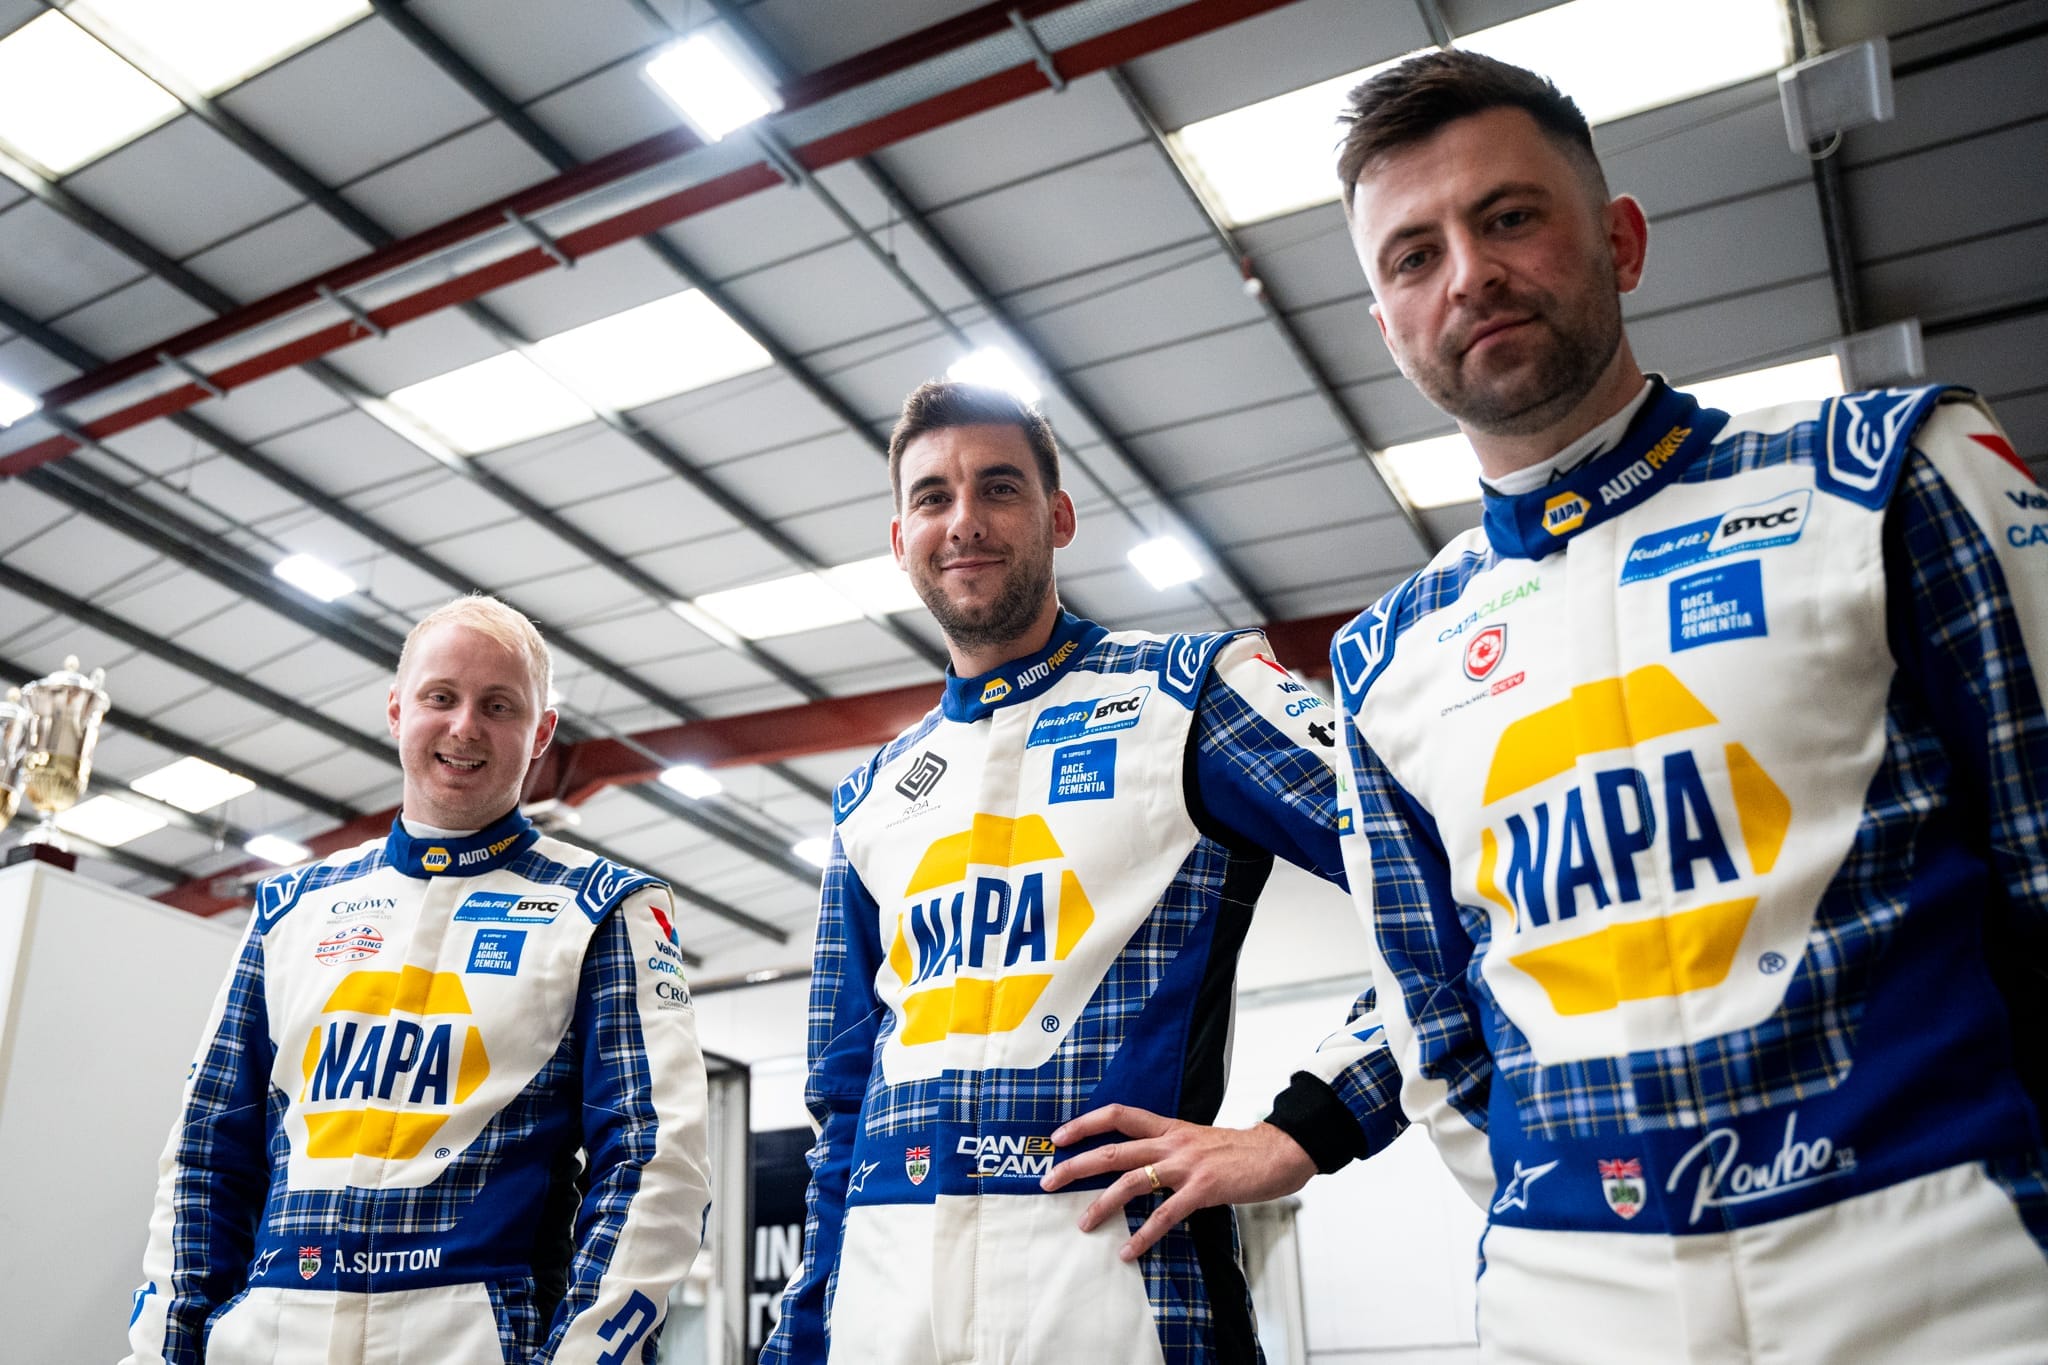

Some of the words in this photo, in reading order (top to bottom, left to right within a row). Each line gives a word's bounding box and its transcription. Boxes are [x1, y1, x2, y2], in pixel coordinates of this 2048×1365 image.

[1549, 501, 1584, 526] NAPA
[1598, 459, 1654, 506] AUTO
[1644, 425, 1693, 470] PARTS
[1722, 507, 1798, 538] BTCC
[1438, 576, 1541, 642] CATACLEAN
[1680, 591, 1714, 611] RACE
[1681, 599, 1739, 625] AGAINST
[1680, 612, 1754, 640] DEMENTIA
[984, 685, 1008, 701] NAPA
[1016, 661, 1051, 690] AUTO
[1047, 640, 1079, 671] PARTS
[1094, 696, 1141, 719] BTCC
[1059, 771, 1099, 785] AGAINST
[1060, 762, 1085, 775] RACE
[1057, 780, 1106, 796] DEMENTIA
[1505, 749, 1741, 935] NAPA
[425, 854, 448, 865] NAPA
[458, 848, 490, 866] AUTO
[331, 897, 398, 915] CROWN
[516, 901, 560, 913] BTCC
[908, 872, 1047, 987] NAPA
[316, 939, 383, 954] SCAFFLDING
[475, 950, 508, 959] AGAINST
[479, 942, 499, 951] RACE
[474, 958, 512, 969] DEMENTIA
[312, 1019, 452, 1105] NAPA
[956, 1135, 1027, 1157] DAN
[1026, 1137, 1054, 1152] 27
[977, 1154, 1054, 1177] CAM
[332, 1247, 442, 1274] A.SUTTON
